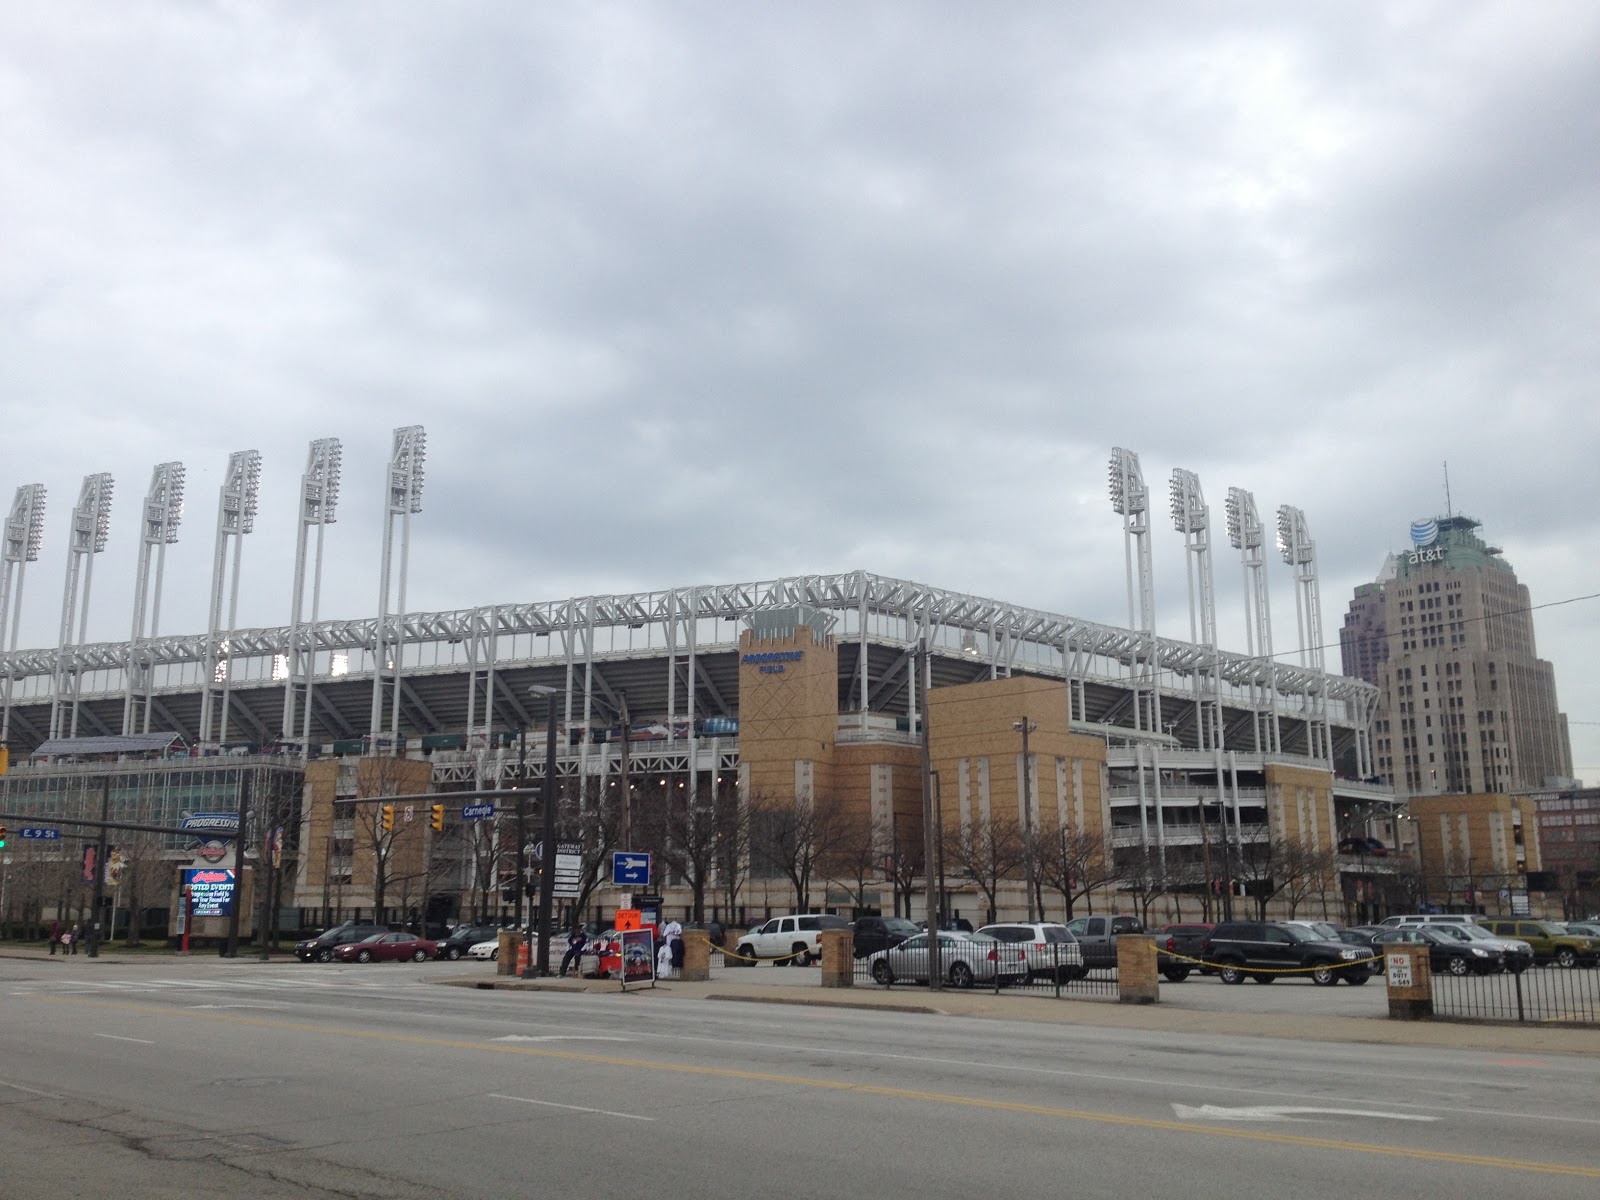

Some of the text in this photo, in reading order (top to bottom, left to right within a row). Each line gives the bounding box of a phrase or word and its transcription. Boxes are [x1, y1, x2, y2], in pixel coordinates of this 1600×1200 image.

[1409, 545, 1443, 564] at&t
[463, 805, 492, 817] Carnegie
[45, 830, 55, 838] St
[1393, 957, 1404, 965] NO
